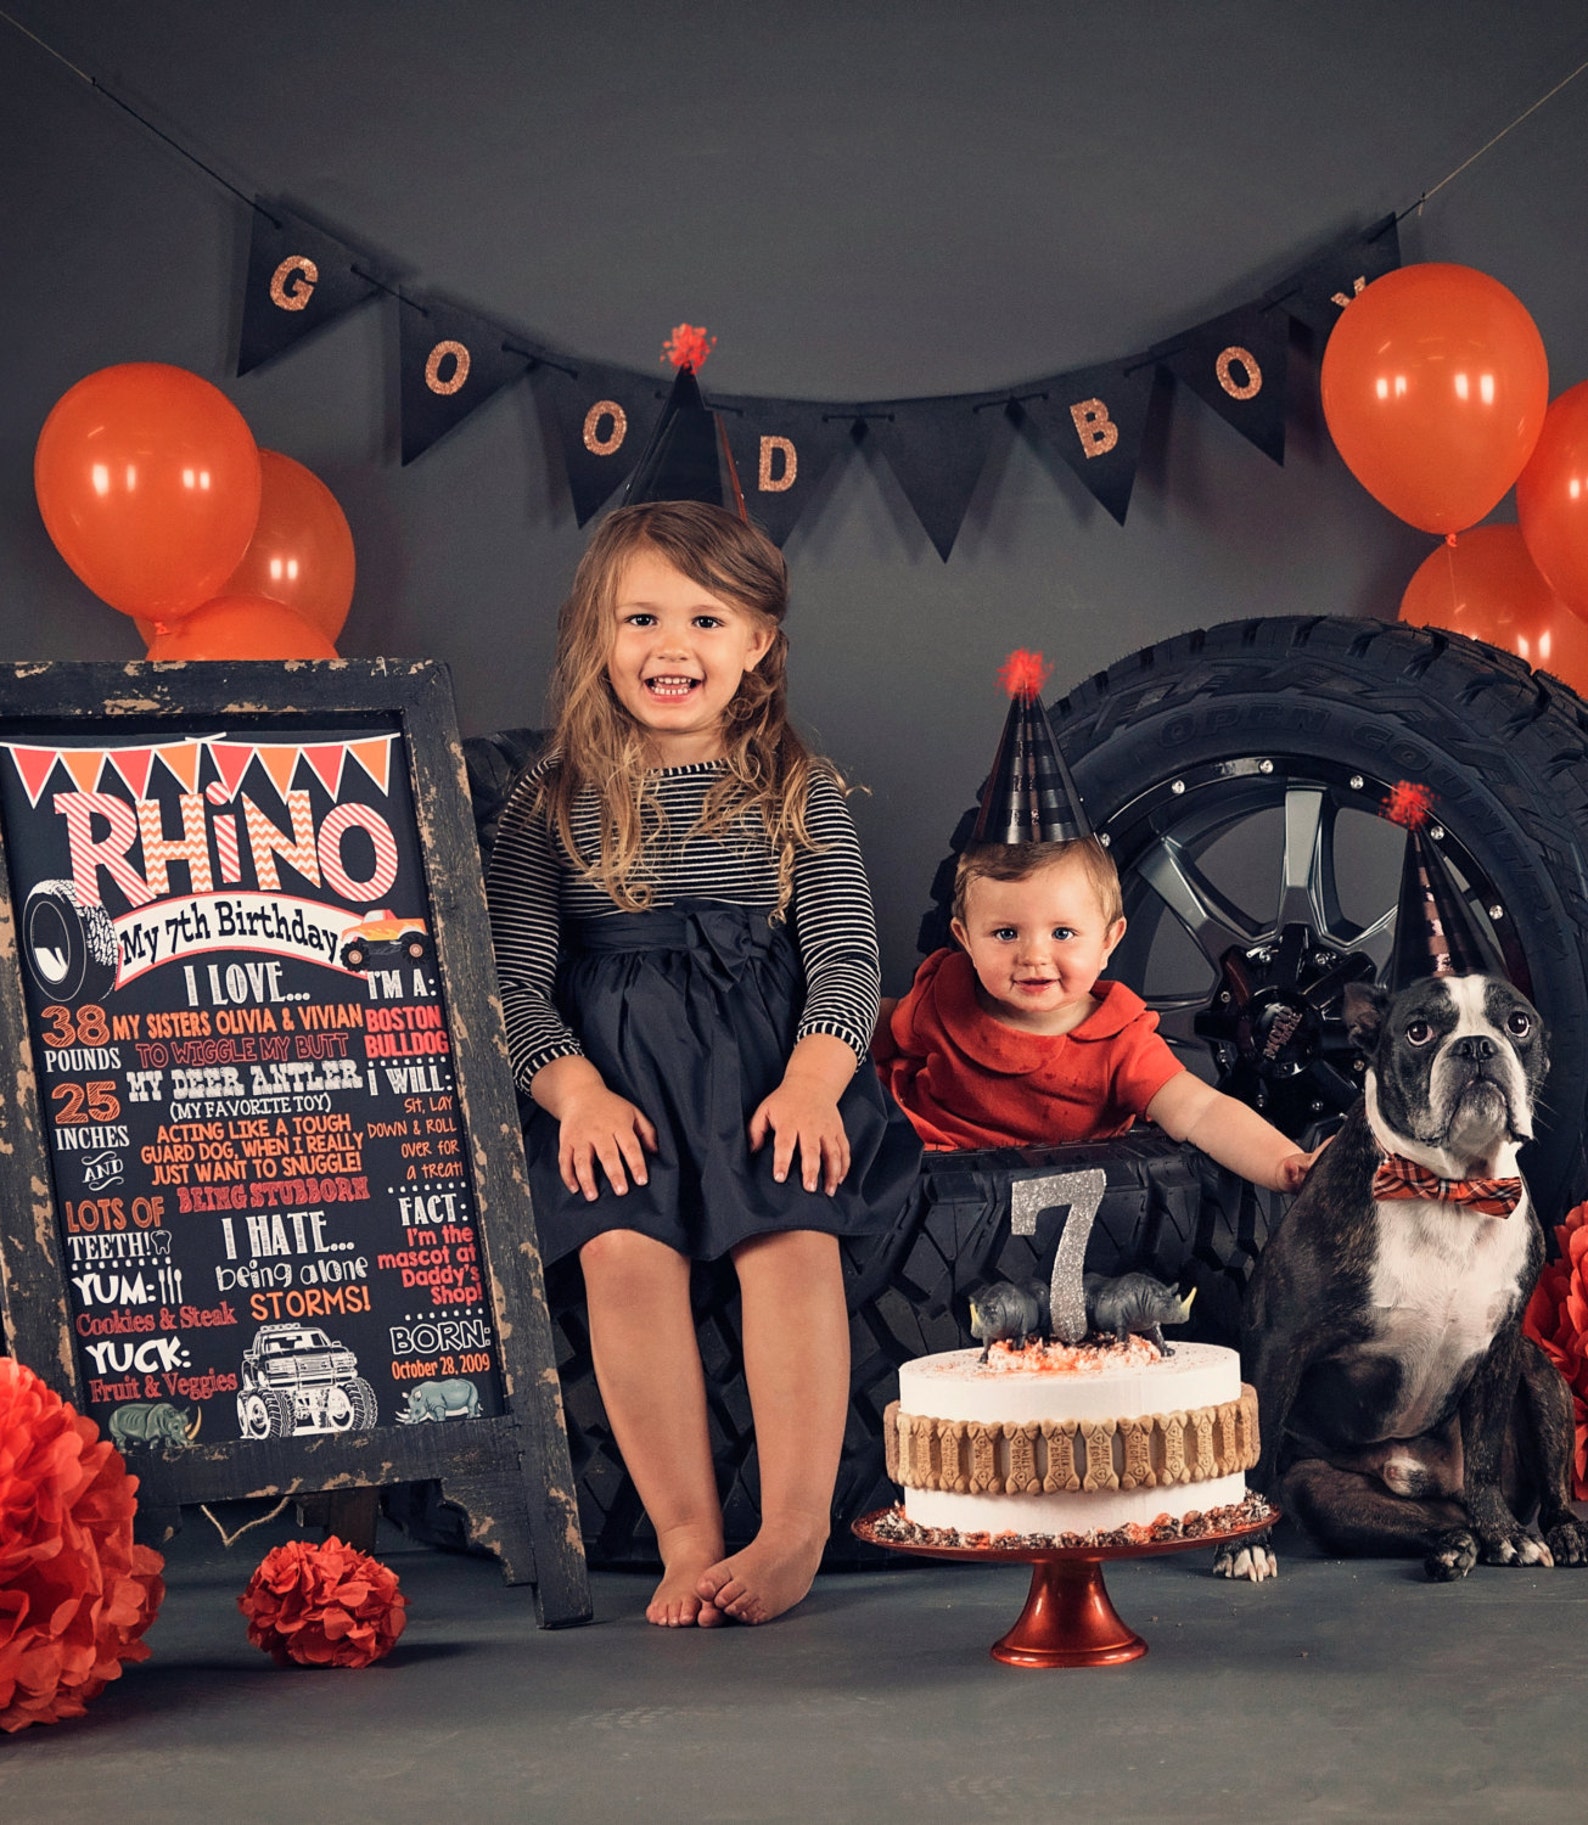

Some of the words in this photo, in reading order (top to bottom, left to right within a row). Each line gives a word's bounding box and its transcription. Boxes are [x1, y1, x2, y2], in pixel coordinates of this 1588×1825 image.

[1158, 702, 1333, 748] OPEN
[120, 923, 159, 964] My
[166, 901, 210, 954] 7th
[214, 900, 339, 964] Birthday
[183, 965, 199, 1007] I
[207, 960, 310, 1006] LOVE...
[366, 969, 403, 1000] I'M
[412, 968, 437, 998] A:
[41, 1004, 111, 1048] 38
[112, 1015, 140, 1041] MY
[146, 1011, 212, 1039] SISTERS
[215, 1007, 277, 1035] OLIVIA
[282, 1007, 295, 1031] &
[298, 1003, 364, 1030] VIVIAN
[364, 1005, 442, 1033] BOSTON
[45, 1047, 121, 1073] POUNDS
[135, 1043, 169, 1069] TO
[170, 1037, 257, 1067] WIGGLE
[261, 1035, 290, 1061] MY
[295, 1033, 349, 1059] BUTT
[364, 1031, 449, 1058] BULLDOG
[126, 1070, 163, 1102] MY
[171, 1066, 245, 1100] DEER
[250, 1059, 364, 1096] ANTLER
[385, 1065, 453, 1094] WILL:
[51, 1080, 121, 1124] 25
[170, 1101, 205, 1122] (MY
[205, 1097, 291, 1119] FAVORITE
[292, 1092, 332, 1113] TOY)
[55, 1125, 130, 1151] INCHES
[157, 1121, 224, 1144] ACTING
[227, 1119, 269, 1140] LIKE
[275, 1117, 289, 1136] A
[292, 1113, 352, 1135] TOUGH
[367, 1120, 408, 1139] DOWN
[413, 1120, 421, 1135] &
[426, 1117, 457, 1134] ROLL
[140, 1144, 195, 1164] GUARD
[198, 1141, 239, 1162] DOG,
[241, 1138, 289, 1158] WHEN
[292, 1136, 304, 1155] I
[306, 1132, 364, 1154] REALLY
[82, 1158, 124, 1184] AND
[152, 1164, 190, 1186] JUST
[194, 1160, 248, 1182] WANT
[252, 1159, 277, 1178] TO
[281, 1151, 363, 1176] SNUGGLE!
[406, 1165, 417, 1180] a
[176, 1184, 247, 1214] BEING
[249, 1176, 371, 1208] STUBBORN
[398, 1193, 469, 1226] FACT:
[65, 1197, 127, 1233] LOTS
[131, 1196, 165, 1228] OF
[67, 1231, 152, 1261] TEETH!
[221, 1217, 237, 1260] I
[245, 1210, 355, 1258] HATE...
[406, 1227, 437, 1247] I'm
[441, 1224, 474, 1243] the
[377, 1245, 450, 1270] mascot
[455, 1243, 477, 1262] at
[1011, 1168, 1107, 1344] 7
[71, 1270, 157, 1306] YUM:
[215, 1258, 293, 1292] being
[300, 1256, 368, 1285] alone
[401, 1264, 480, 1288] Daddy's
[250, 1285, 371, 1321] STORMS!
[430, 1281, 483, 1307] Shop!
[76, 1307, 155, 1337] Cookies
[159, 1306, 177, 1331] &
[179, 1301, 239, 1329] Steak
[389, 1319, 491, 1355] BORN:
[85, 1335, 191, 1375] YUCK:
[391, 1358, 438, 1380] October
[439, 1355, 459, 1376] 28,
[460, 1353, 491, 1373] 2009
[89, 1374, 141, 1403] Fruit
[144, 1374, 162, 1399] &
[162, 1367, 239, 1401] Veggies
